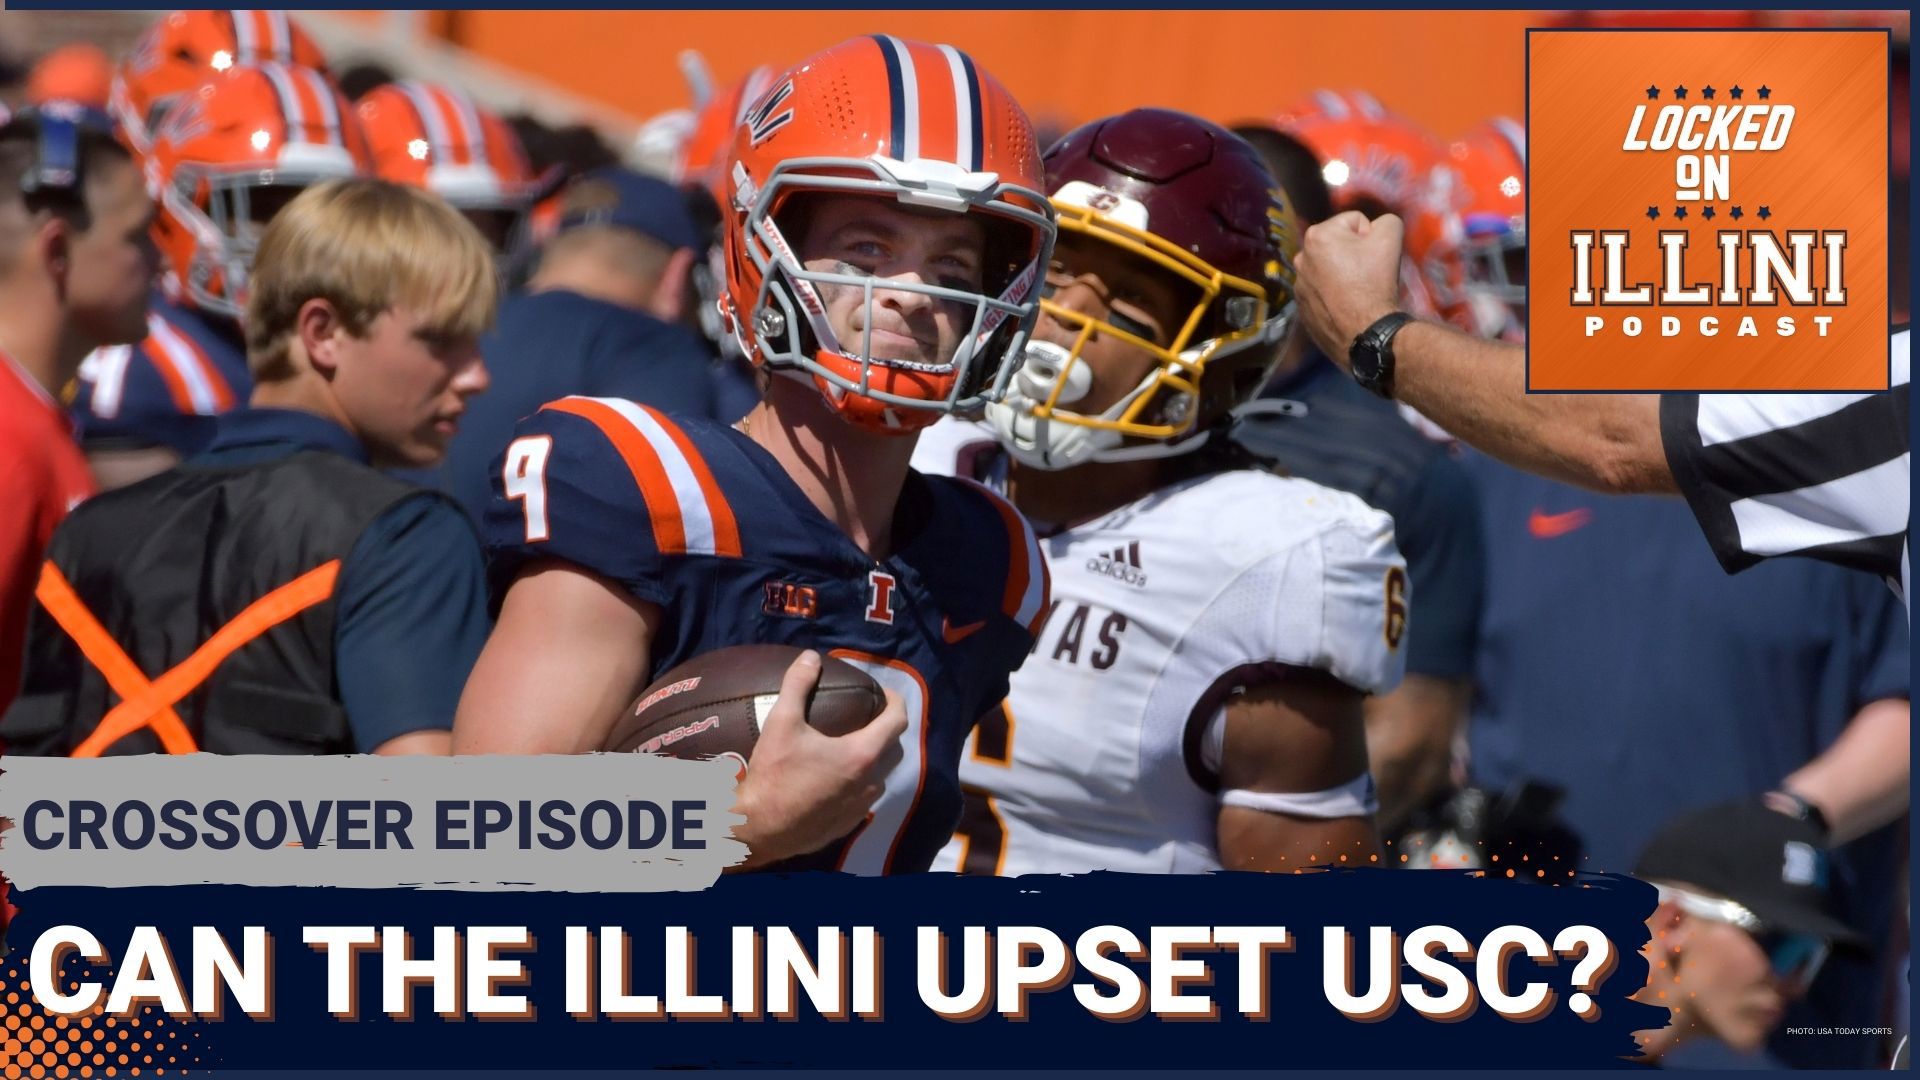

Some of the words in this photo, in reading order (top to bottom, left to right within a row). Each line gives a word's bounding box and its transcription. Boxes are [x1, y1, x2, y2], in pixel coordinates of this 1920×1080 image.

[502, 434, 553, 543] 9
[865, 570, 895, 626] I
[1086, 558, 1147, 587] adidas
